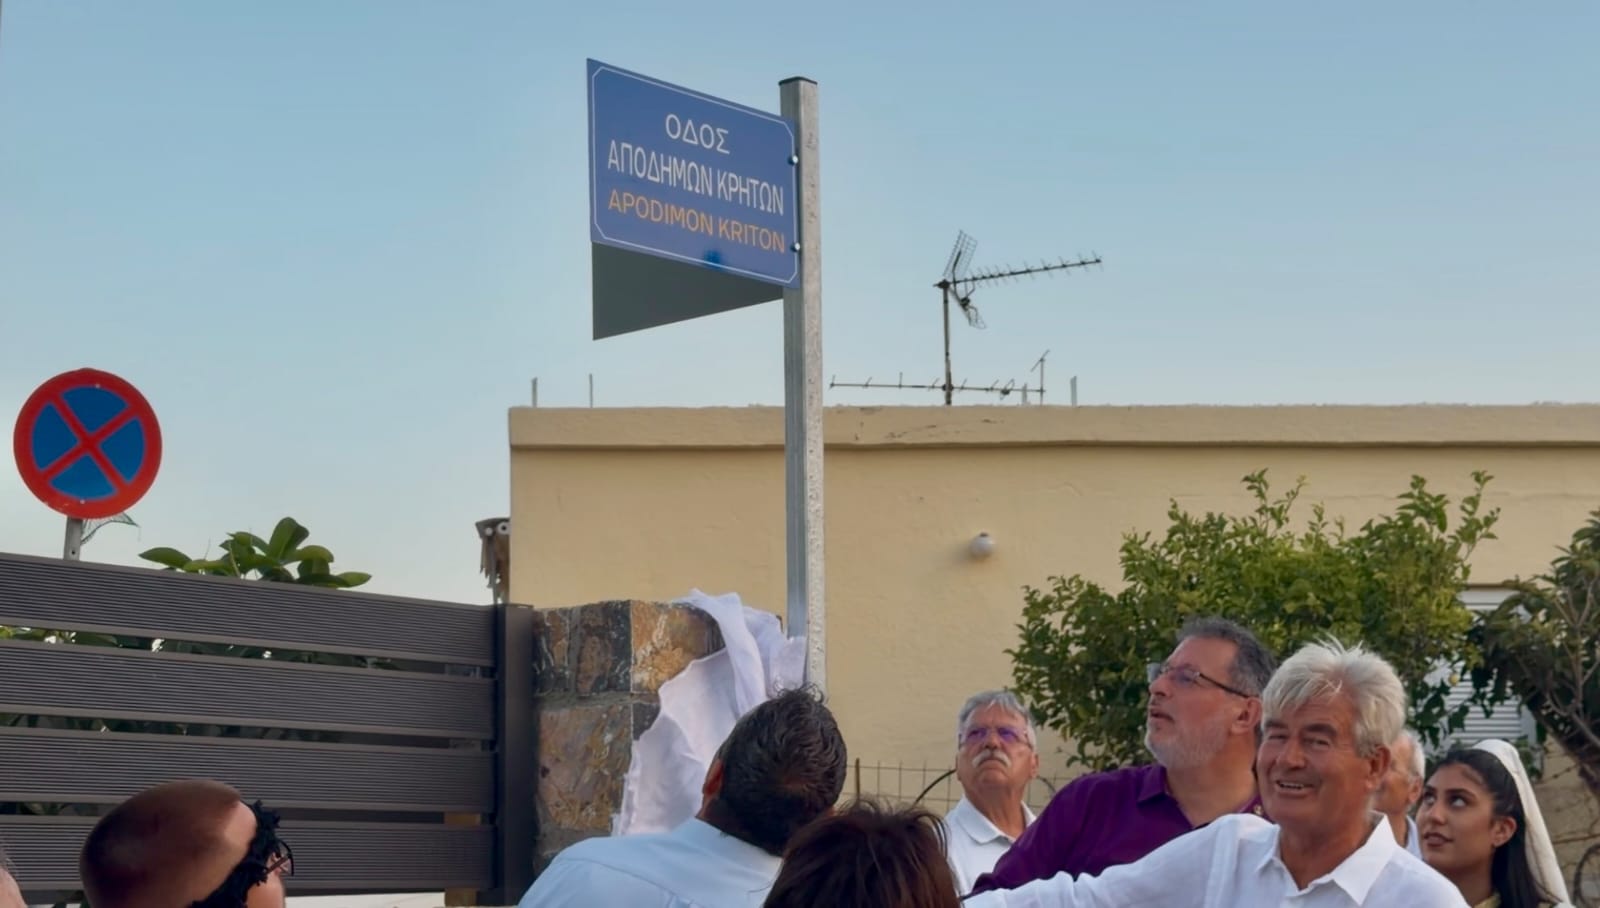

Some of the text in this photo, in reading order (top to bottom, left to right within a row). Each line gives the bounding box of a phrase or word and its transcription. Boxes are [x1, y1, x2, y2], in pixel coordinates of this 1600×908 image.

[665, 113, 730, 154] ΟΔΟΣ
[608, 139, 784, 216] ΑΠΟΔΗΜΩΝ ΚΡΗΤΩΝ
[608, 189, 785, 254] APODIMON KRITON
